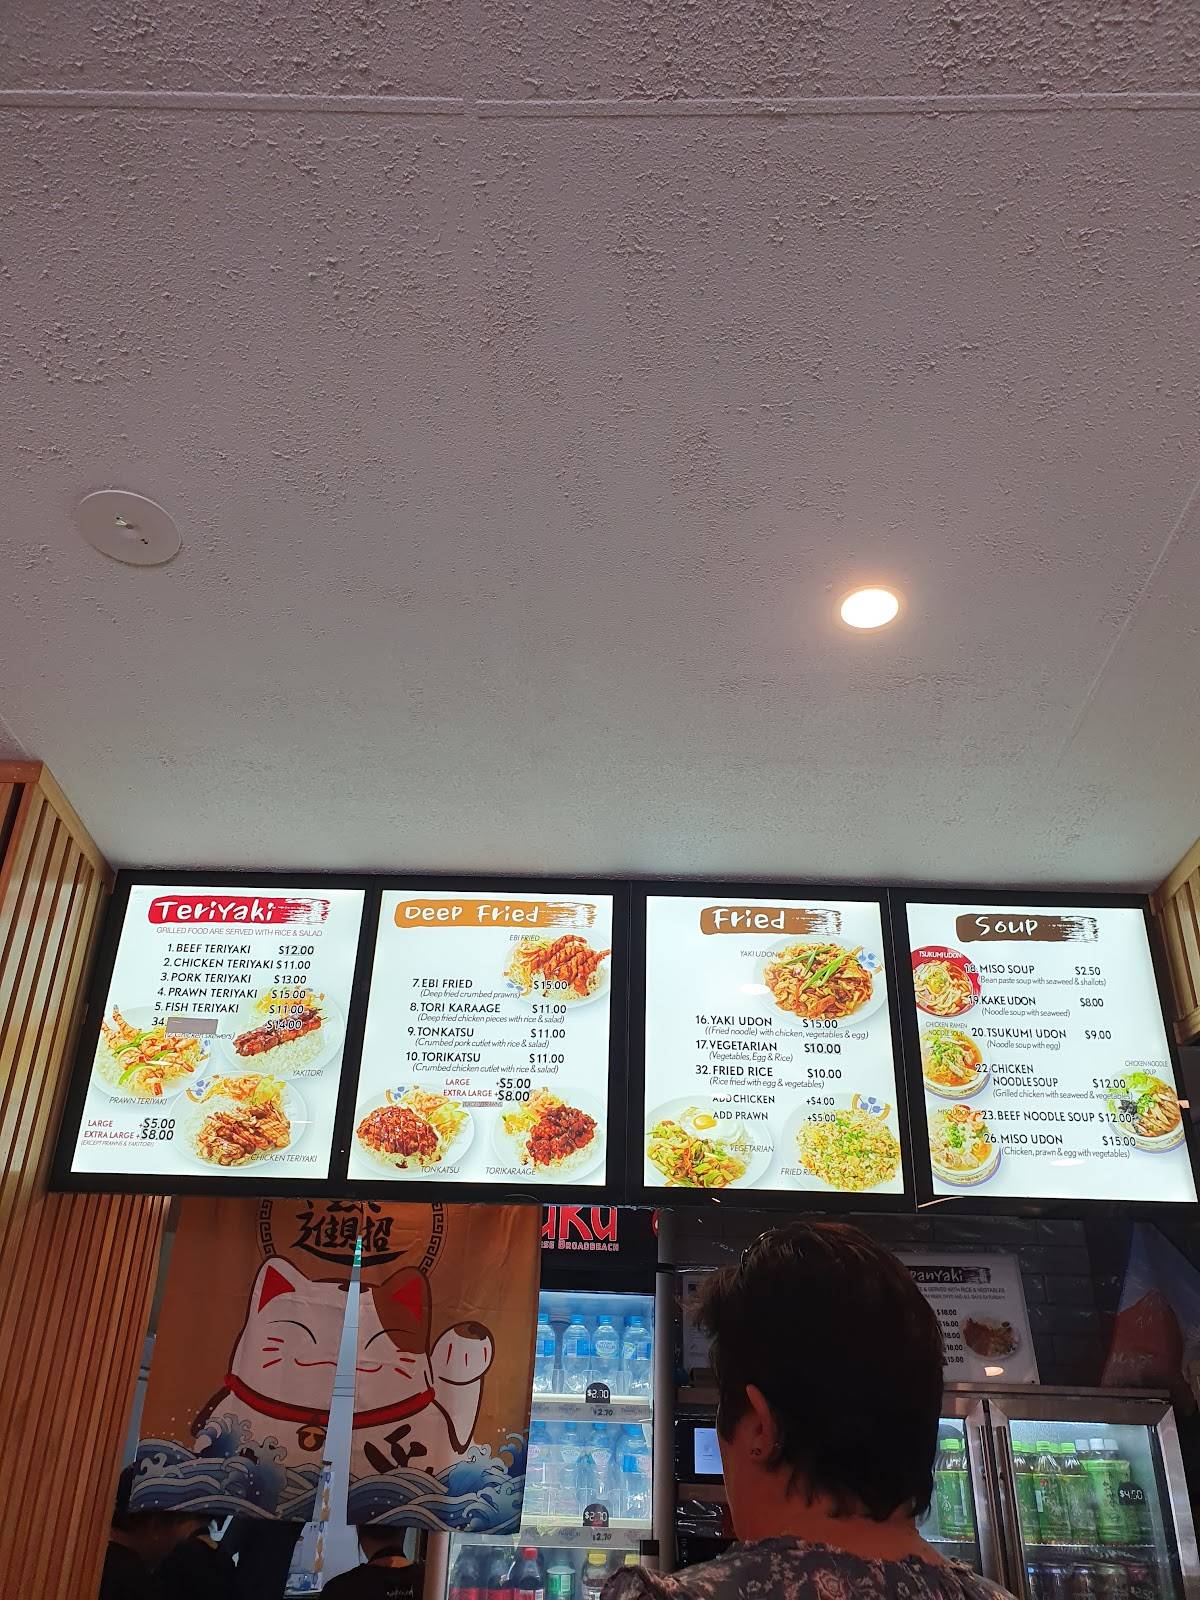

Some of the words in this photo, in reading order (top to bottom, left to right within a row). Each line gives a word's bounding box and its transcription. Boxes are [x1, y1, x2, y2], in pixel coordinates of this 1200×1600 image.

[477, 905, 538, 922] Fried
[713, 909, 785, 929] Fried
[975, 916, 1038, 936] Soup
[176, 944, 202, 952] BEEF
[205, 944, 250, 954] TERIYAKI
[279, 945, 314, 956] $12.00
[174, 958, 223, 968] CHICKEN
[228, 959, 273, 969] TERIYAKI
[980, 963, 1005, 973] MISO
[1008, 965, 1035, 974] SOUP
[1075, 966, 1101, 975] $2.50
[171, 973, 200, 982] PORK
[205, 973, 251, 983] TERIYAKI
[422, 979, 439, 988] EBI
[443, 979, 472, 988] FRIED
[534, 981, 568, 989] $15.00
[1046, 977, 1073, 985] seaweed
[1081, 978, 1106, 987] shallots)
[168, 987, 206, 997] PRAWN
[211, 988, 257, 998] TERIYAKI
[421, 989, 441, 999] (Deep
[460, 990, 491, 998] crumbed
[493, 989, 520, 999] prawns)
[982, 995, 1006, 1005] KAKE
[1008, 996, 1035, 1006] UDON
[1080, 997, 1103, 1007] $8.00
[165, 1002, 188, 1012] FISH
[192, 1003, 239, 1013] TERIYAKI
[421, 1003, 445, 1012] TORI
[449, 1003, 500, 1013] KARAAGE
[532, 1004, 566, 1014] $11.00
[982, 1007, 1009, 1016] (Noodle
[1041, 1009, 1070, 1018] seaweed)
[418, 1013, 439, 1023] (Deep
[457, 1014, 484, 1022] chicken
[544, 1015, 565, 1024] salad)
[710, 1015, 734, 1025] YAKI
[739, 1016, 772, 1026] UDON
[803, 1019, 837, 1029] $15.00
[418, 1026, 474, 1038] TONKATSU
[531, 1028, 565, 1038] $11.00
[730, 1026, 757, 1036] noodle)
[759, 1028, 774, 1036] with
[775, 1029, 804, 1038] chicken,
[806, 1028, 843, 1039] vegetables
[987, 1028, 1032, 1038] TSUKUMI
[1036, 1029, 1066, 1038] UDON
[1085, 1030, 1111, 1040] $9.00
[415, 1037, 453, 1046] (Crumbed
[454, 1039, 472, 1048] pork
[473, 1038, 491, 1047] cutlet
[492, 1039, 506, 1047] with
[528, 1040, 549, 1049] salad)
[710, 1040, 777, 1052] VEGETARIAN
[805, 1044, 841, 1054] $10.00
[987, 1040, 1014, 1048] (Noodle
[1046, 1041, 1060, 1051] egg)
[422, 1052, 481, 1063] TORIKATSU
[529, 1053, 564, 1063] $11.00
[709, 1050, 750, 1062] (Vegetables,
[774, 1053, 793, 1063] Rice)
[413, 1063, 450, 1072] (Crumbed
[452, 1064, 479, 1072] chicken
[481, 1064, 499, 1072] cutlet
[500, 1064, 514, 1072] with
[537, 1064, 558, 1074] salad)
[713, 1065, 744, 1076] FRIED
[748, 1067, 773, 1076] RICE
[808, 1068, 841, 1077] $10.00
[991, 1064, 1033, 1075] CHICKEN
[710, 1076, 728, 1086] (Rice
[747, 1078, 761, 1086] with
[785, 1080, 824, 1089] vegetables)
[993, 1076, 1032, 1087] NOODLE
[1034, 1077, 1058, 1087] SOUP
[1093, 1079, 1125, 1089] $12.00
[733, 1096, 775, 1104] CHICKEN
[993, 1089, 1018, 1098] (Grilled
[1020, 1089, 1044, 1098] chicken
[1096, 1090, 1132, 1101] vegetables)
[736, 1112, 768, 1120] PRAWN
[997, 1110, 1020, 1120] BEEF
[1024, 1111, 1065, 1121] NOODLE
[1068, 1112, 1094, 1122] SOUP
[88, 1119, 113, 1128] LARGE
[84, 1131, 108, 1139] EXTRA
[110, 1130, 134, 1139] LARGE
[1001, 1134, 1028, 1144] MISO
[1032, 1134, 1063, 1144] UDON
[1102, 1136, 1135, 1147] $15.00
[251, 1153, 285, 1163] CHICKEN
[1002, 1146, 1034, 1156] (Chicken,
[1036, 1149, 1056, 1157] prawn
[1092, 1148, 1130, 1159] vegetables)
